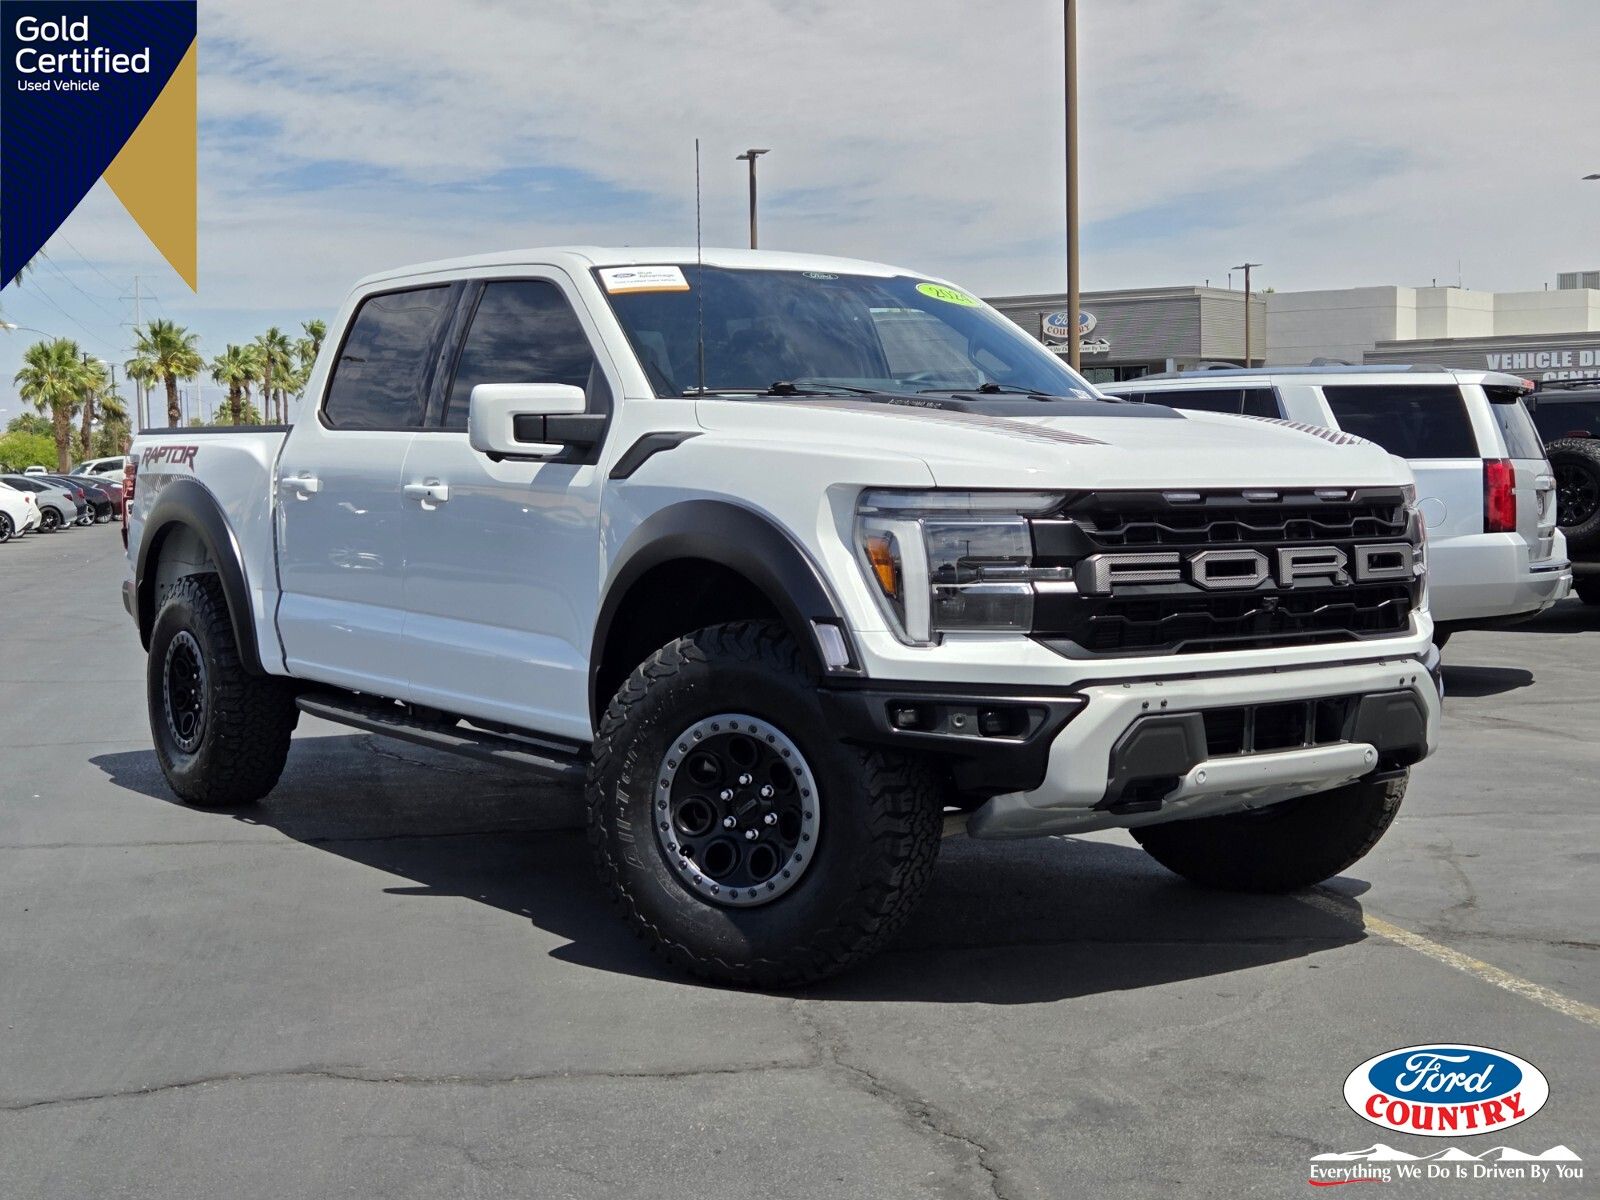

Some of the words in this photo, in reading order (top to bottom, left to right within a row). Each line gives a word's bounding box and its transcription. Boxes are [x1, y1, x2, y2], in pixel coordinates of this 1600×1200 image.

[1486, 352, 1572, 370] VEHICLE
[142, 446, 198, 472] RAPTOR
[1076, 542, 1417, 598] FORD
